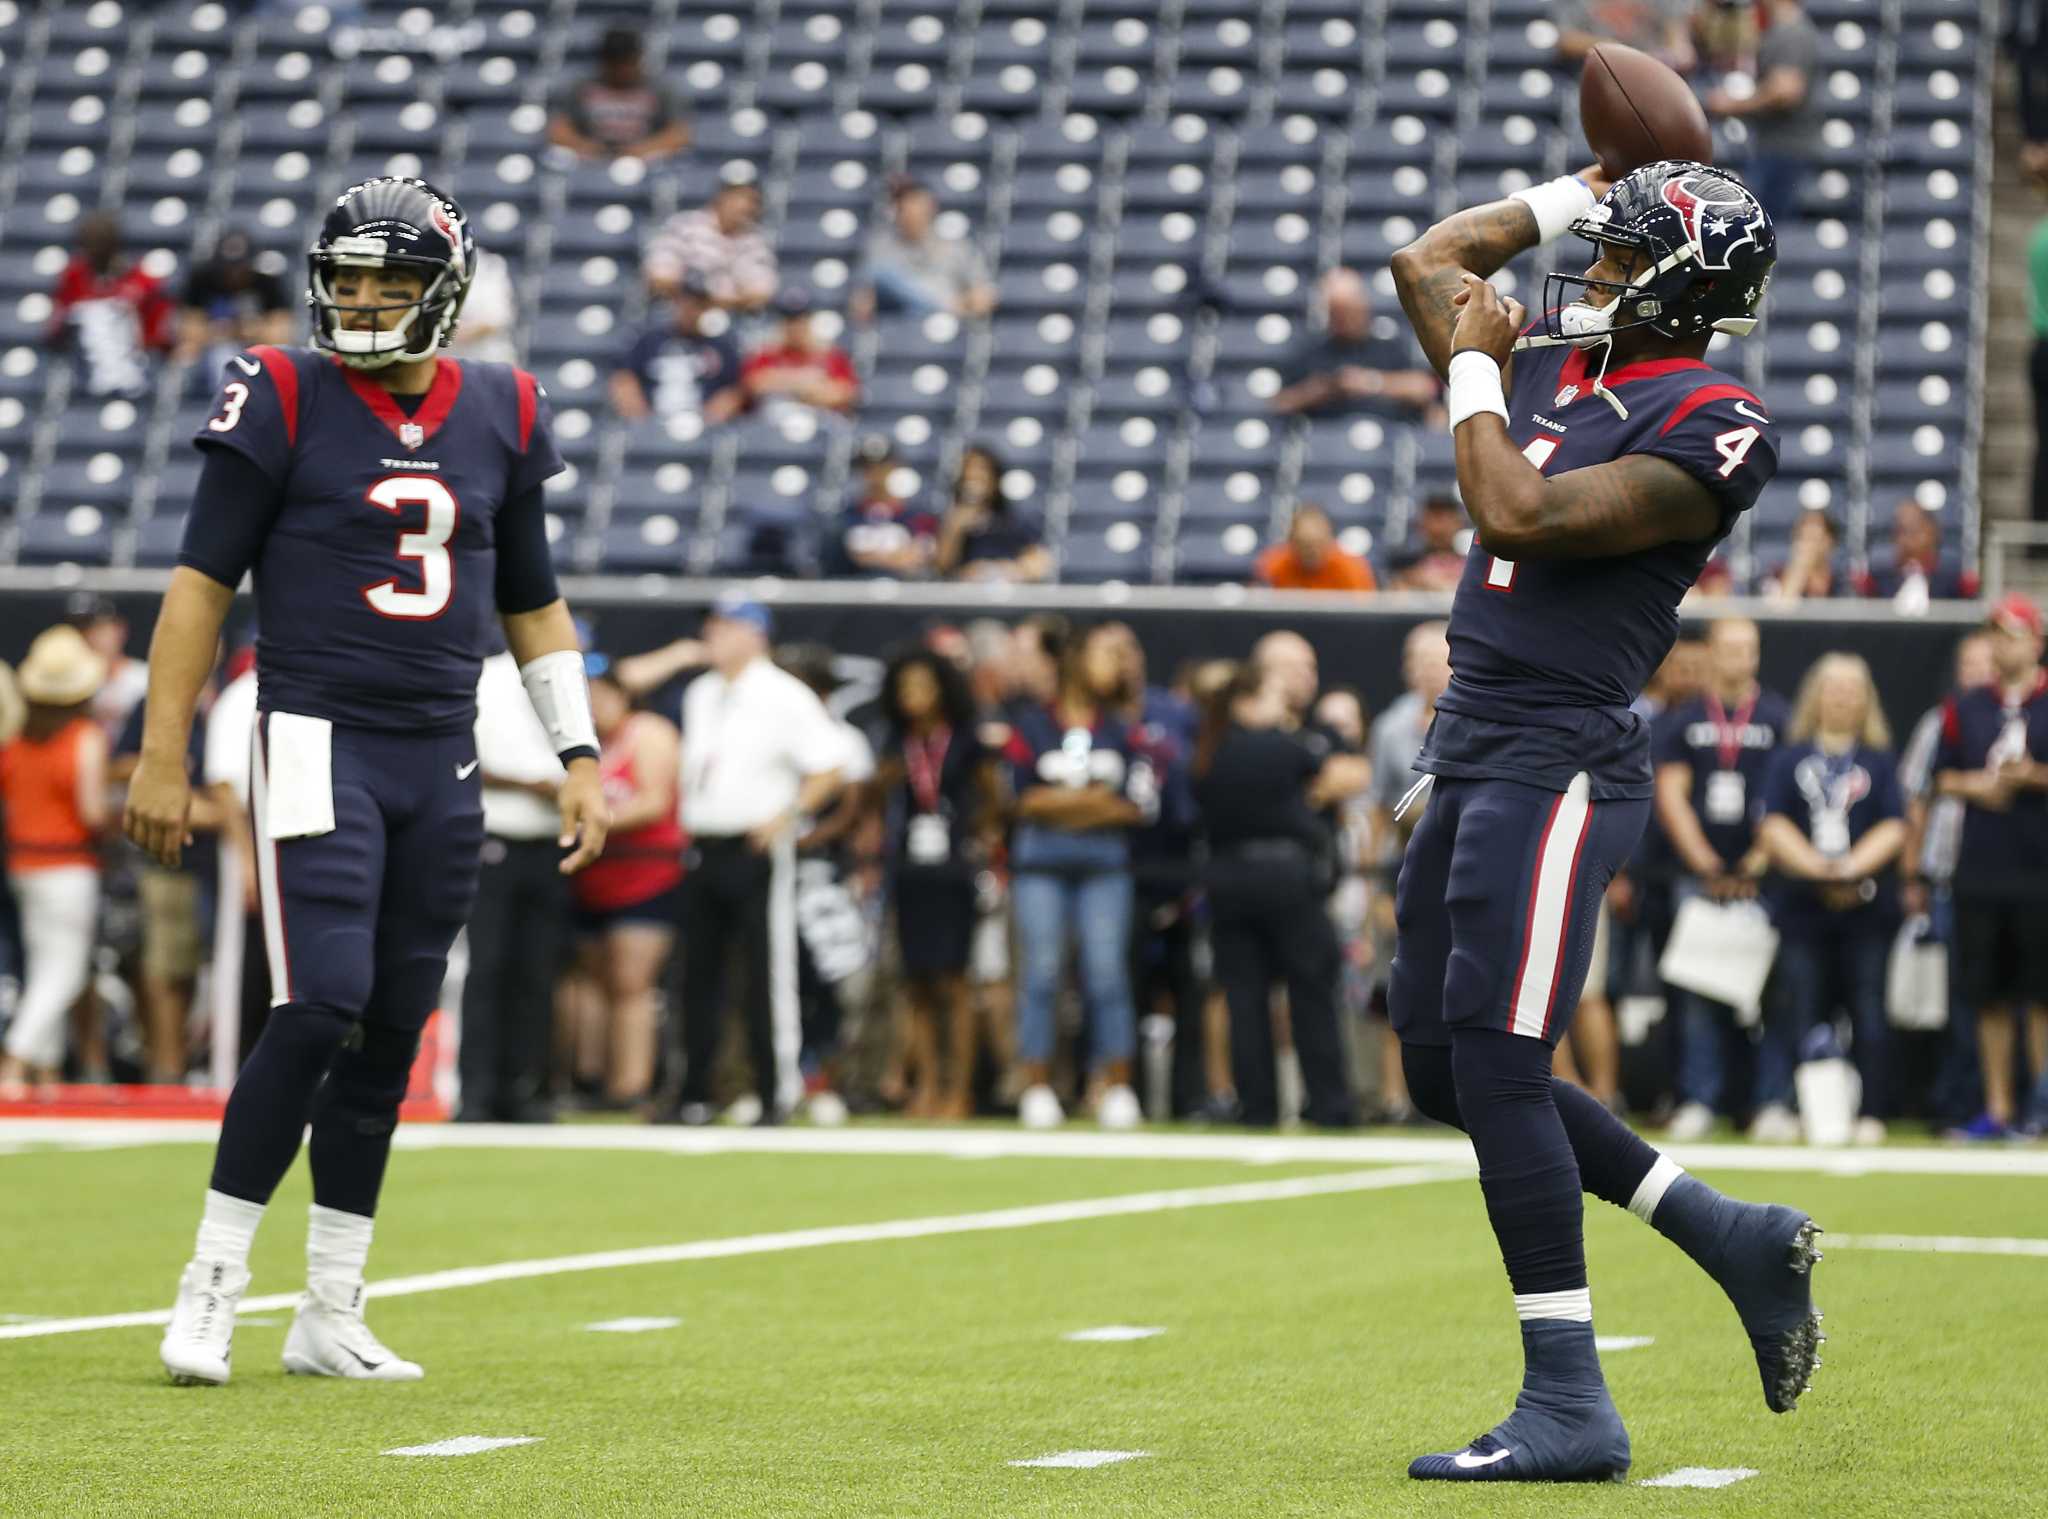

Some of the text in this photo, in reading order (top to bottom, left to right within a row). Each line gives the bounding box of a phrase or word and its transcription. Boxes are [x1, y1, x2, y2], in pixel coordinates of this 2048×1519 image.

[208, 381, 249, 433] 3
[1532, 413, 1568, 433] TEXANS
[380, 458, 441, 471] TEXANS
[1714, 425, 1760, 479] 4
[362, 474, 460, 620] 3
